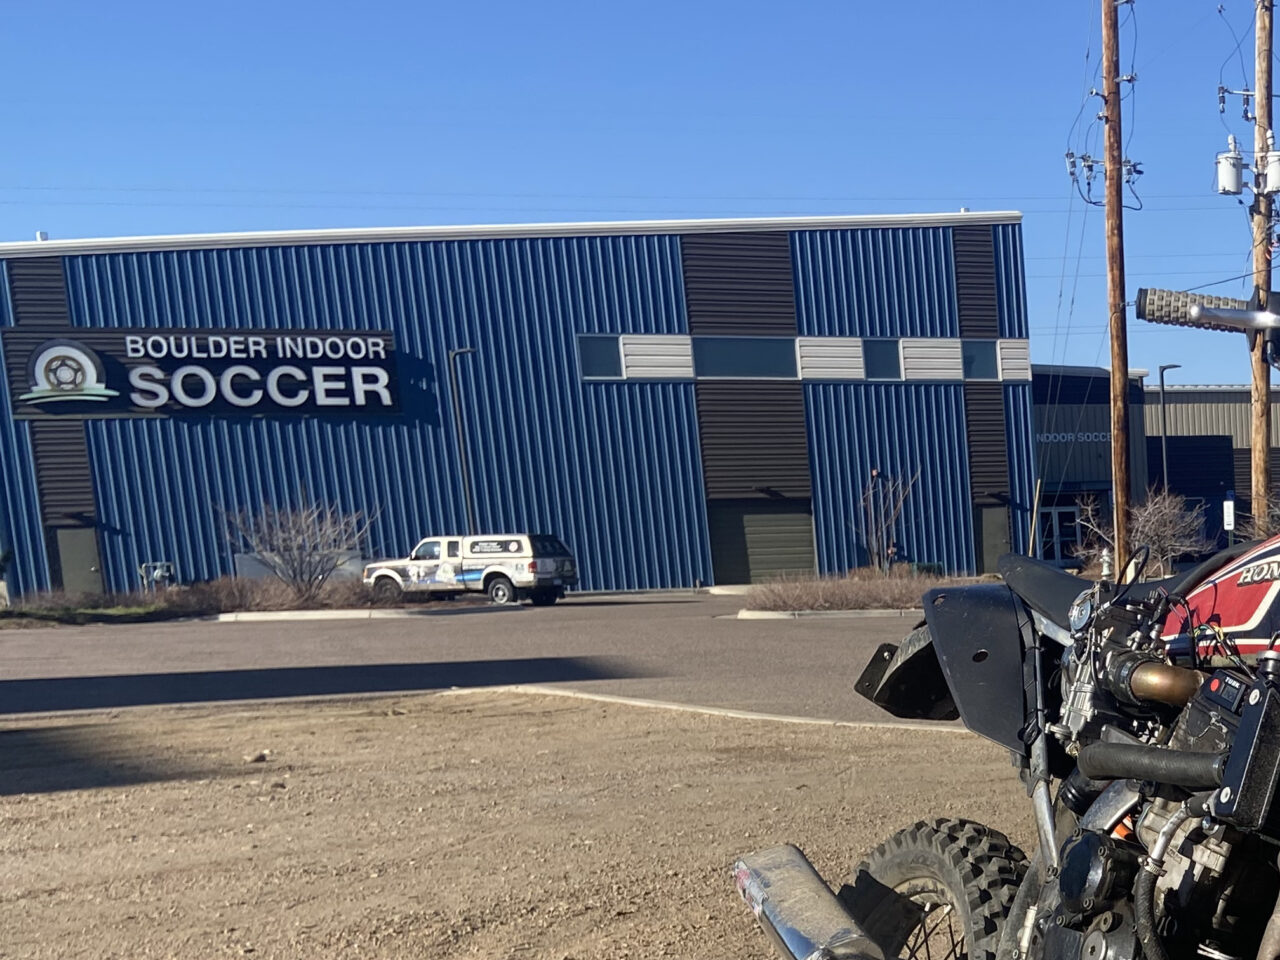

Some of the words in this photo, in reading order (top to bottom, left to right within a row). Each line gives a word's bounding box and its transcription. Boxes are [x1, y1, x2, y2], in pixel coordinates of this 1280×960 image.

[125, 335, 267, 360] BOULDER
[276, 337, 387, 360] INDOOR
[128, 364, 393, 408] SOCCER
[1036, 433, 1075, 443] NDOOR
[1078, 432, 1112, 442] SOCCE
